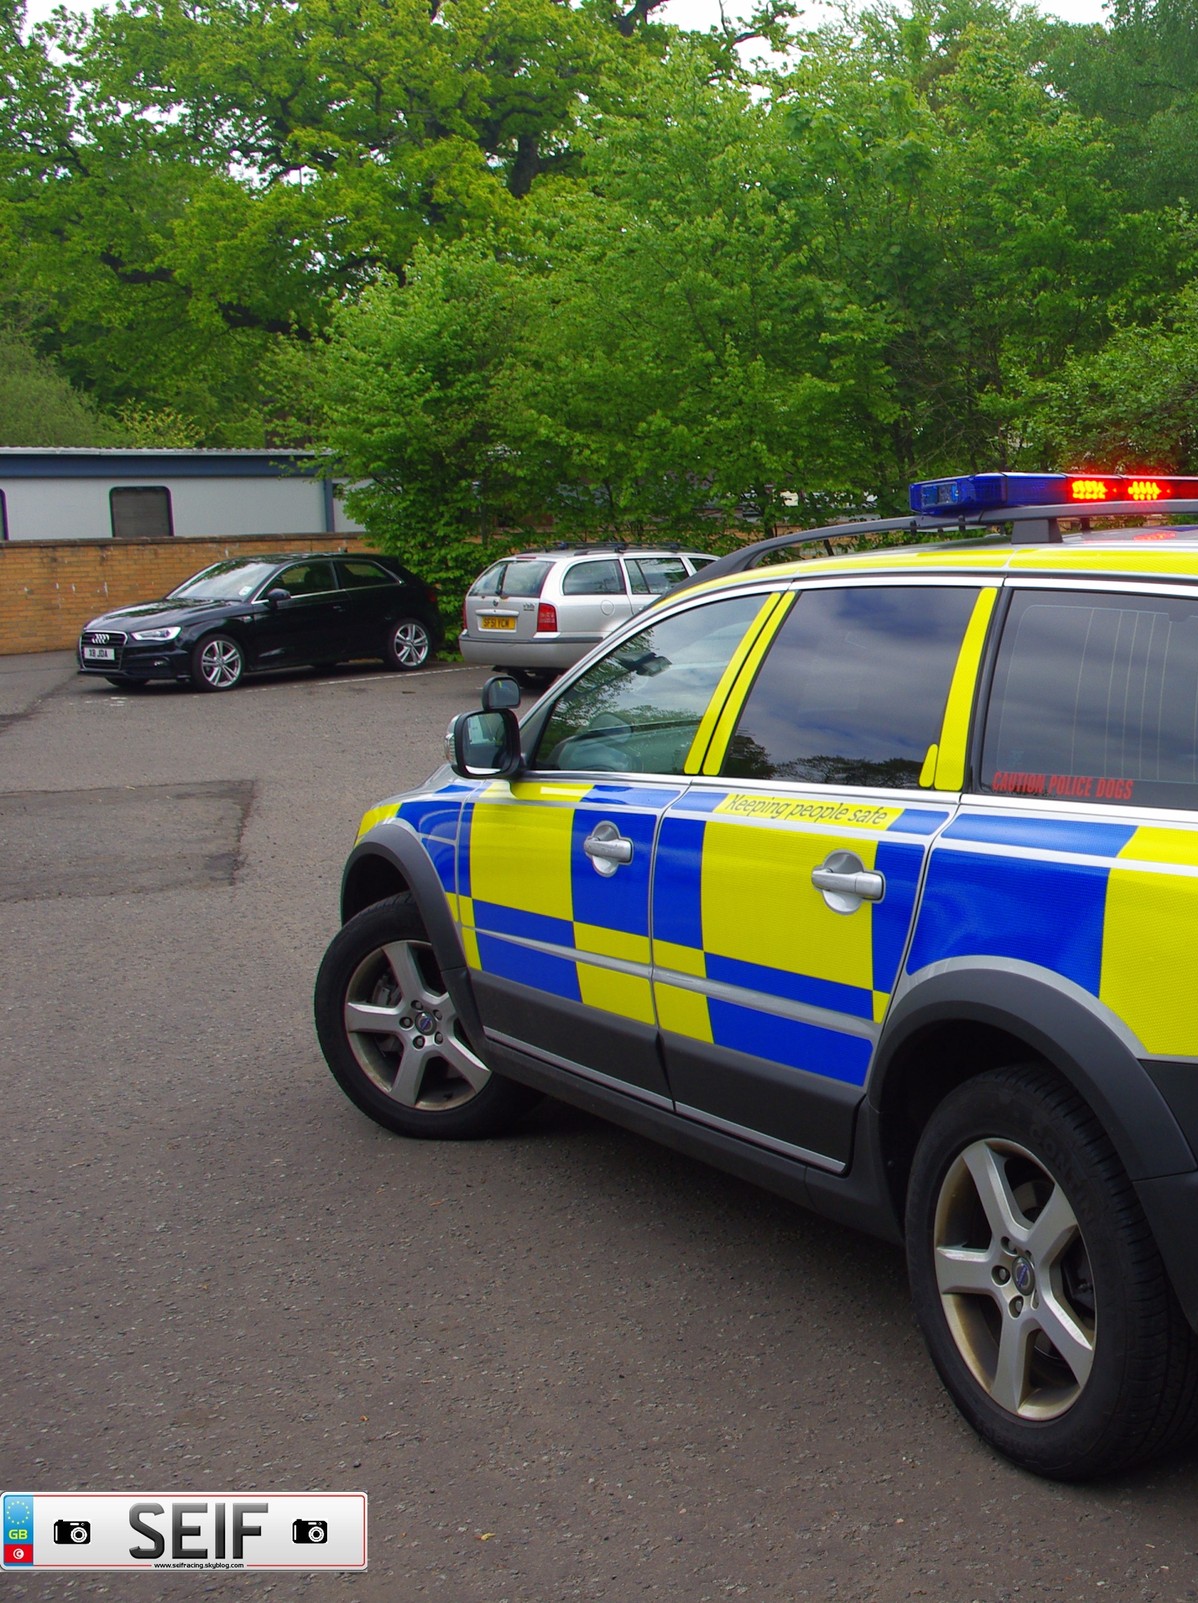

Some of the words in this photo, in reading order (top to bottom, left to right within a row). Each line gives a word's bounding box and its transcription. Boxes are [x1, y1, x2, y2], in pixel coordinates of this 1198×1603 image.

[992, 771, 1046, 795] CAUTION
[1047, 774, 1093, 797] POLICE
[1095, 777, 1134, 800] DOGS
[725, 794, 790, 819] Keeping
[784, 802, 849, 823] people
[847, 807, 888, 825] safe
